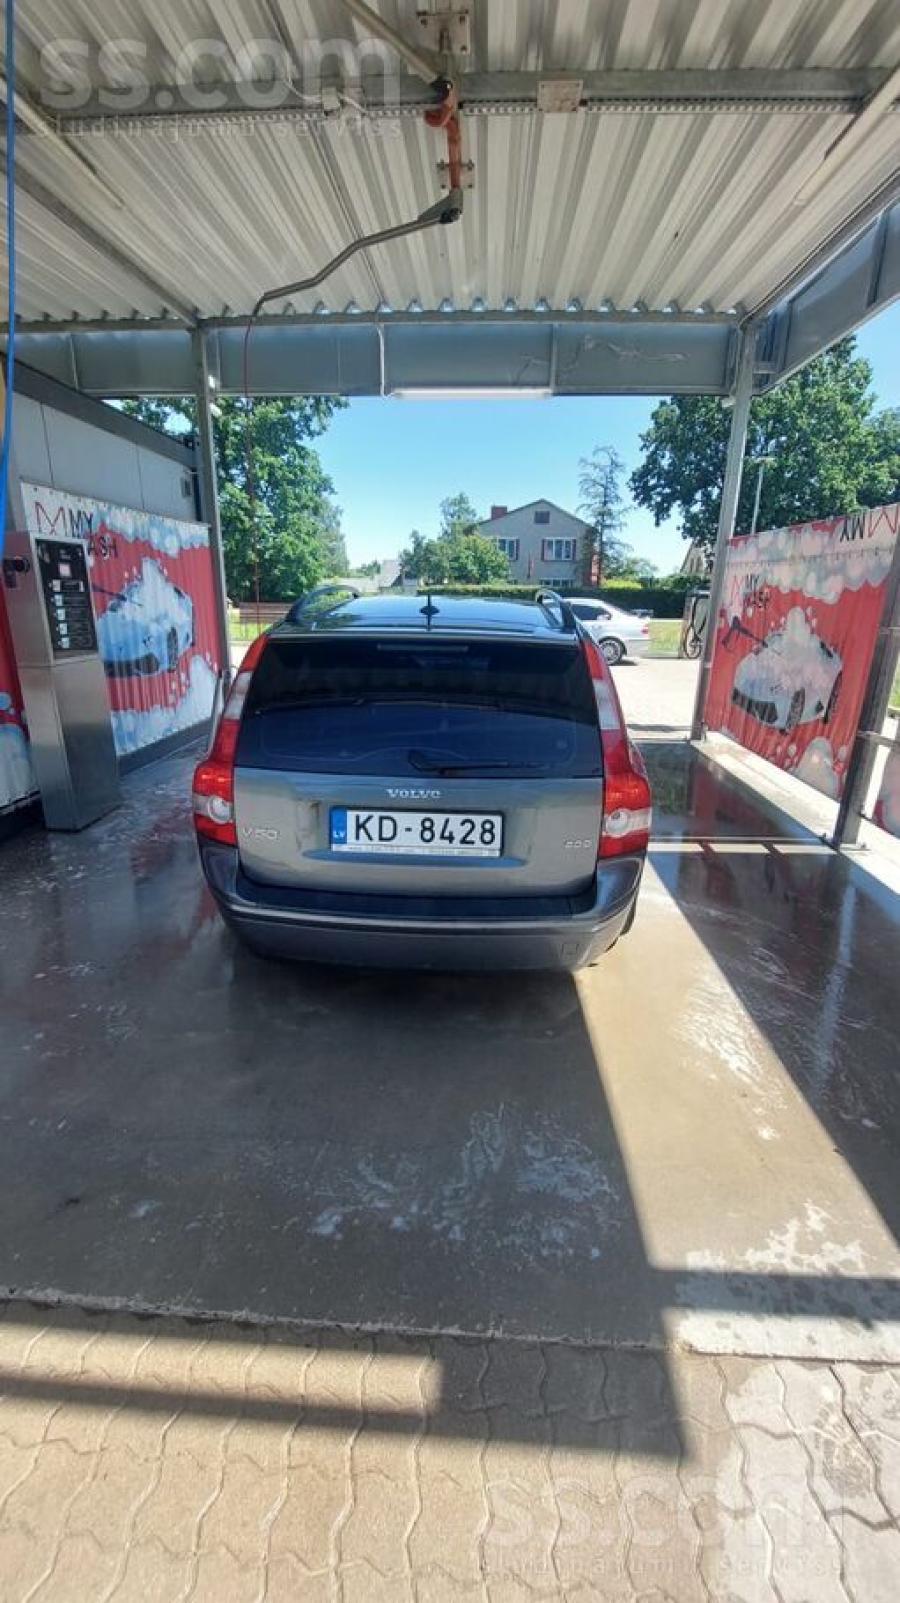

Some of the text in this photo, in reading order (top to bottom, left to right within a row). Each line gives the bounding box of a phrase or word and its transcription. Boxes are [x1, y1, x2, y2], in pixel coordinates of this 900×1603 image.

[69, 508, 93, 538] MY
[87, 532, 119, 559] ASH
[385, 788, 441, 799] VOLVO
[334, 830, 346, 839] LV
[355, 813, 496, 845] KD-8428
